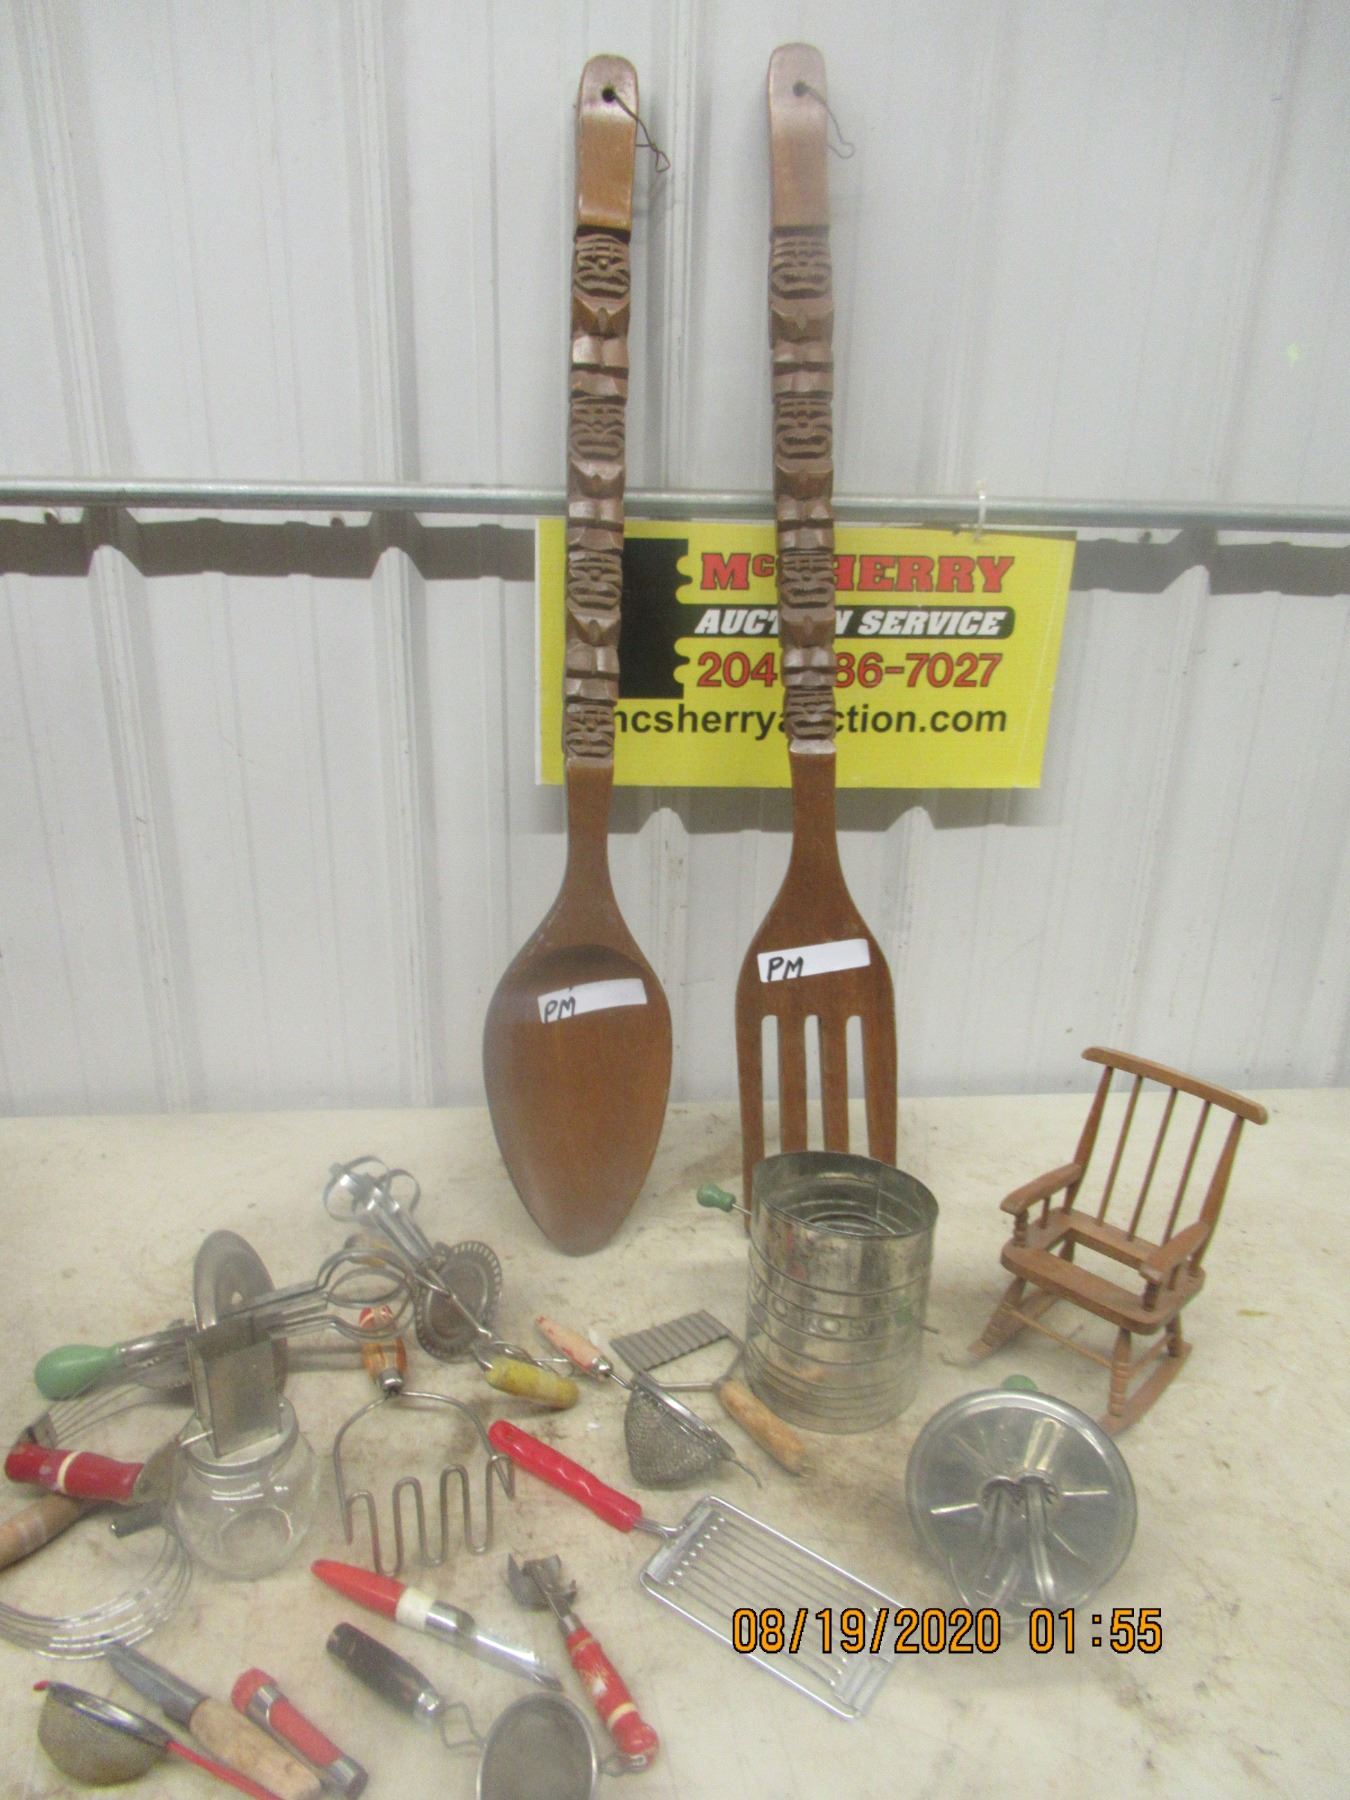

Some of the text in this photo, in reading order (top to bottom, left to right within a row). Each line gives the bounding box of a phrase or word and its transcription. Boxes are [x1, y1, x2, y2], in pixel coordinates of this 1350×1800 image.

[701, 553, 1014, 593] McHERRY
[858, 609, 1005, 636] SERVICE
[697, 652, 1003, 688] 20486-7027
[765, 955, 804, 982] PM
[543, 995, 576, 1022] PM
